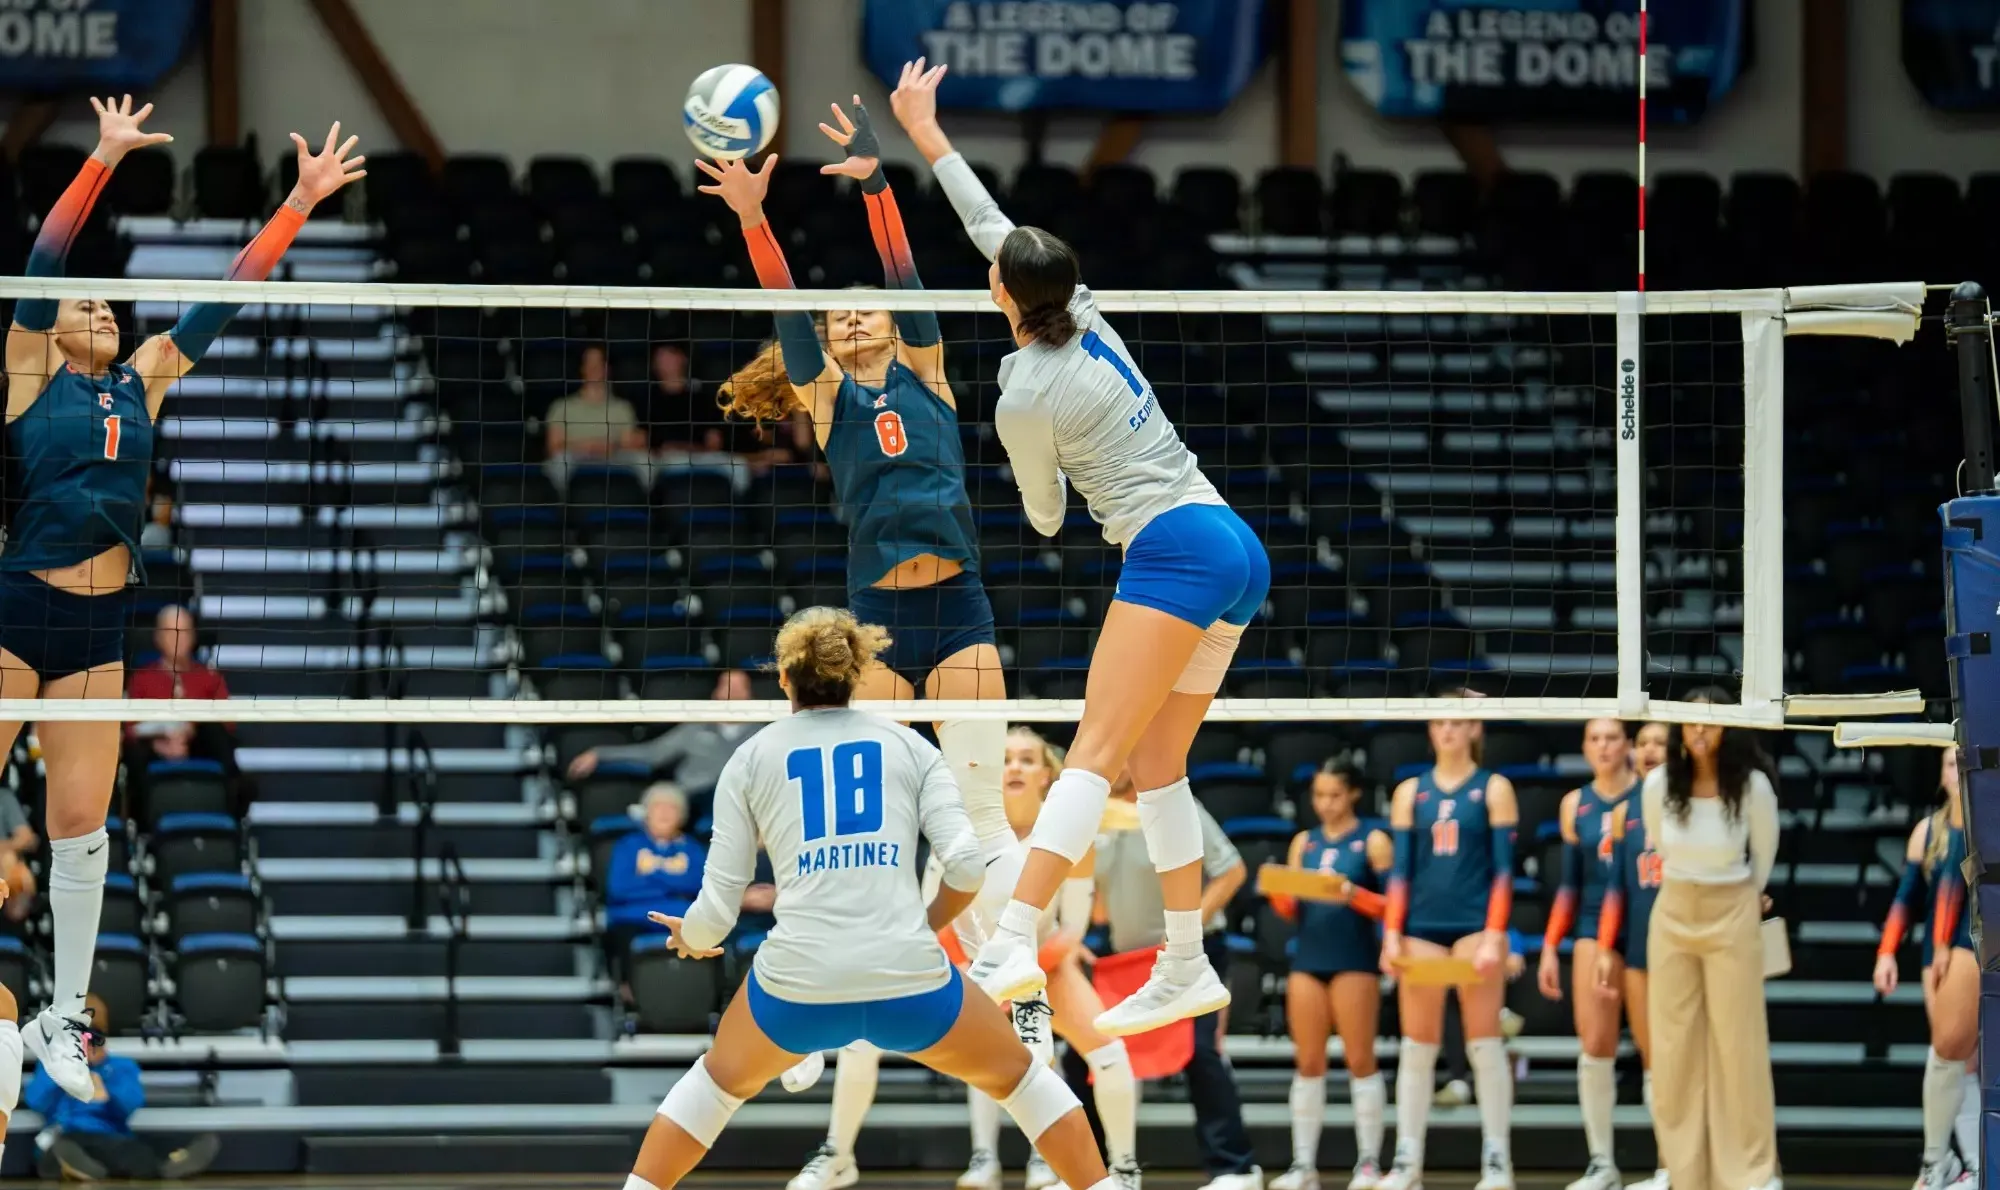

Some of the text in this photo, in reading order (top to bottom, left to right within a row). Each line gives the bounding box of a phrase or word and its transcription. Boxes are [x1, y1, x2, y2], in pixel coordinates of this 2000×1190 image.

[978, 3, 1122, 31] LEGEND
[1126, 3, 1178, 31] OF
[1457, 9, 1598, 40] LEGEND
[922, 32, 1198, 79] THE DOME
[1404, 39, 1671, 88] THE DOME
[1080, 328, 1144, 399] 1
[1621, 374, 1636, 441] Schelde
[104, 415, 121, 460] 1
[874, 410, 908, 457] 8
[785, 740, 884, 843] 18
[797, 843, 900, 876] MARTINEZ
